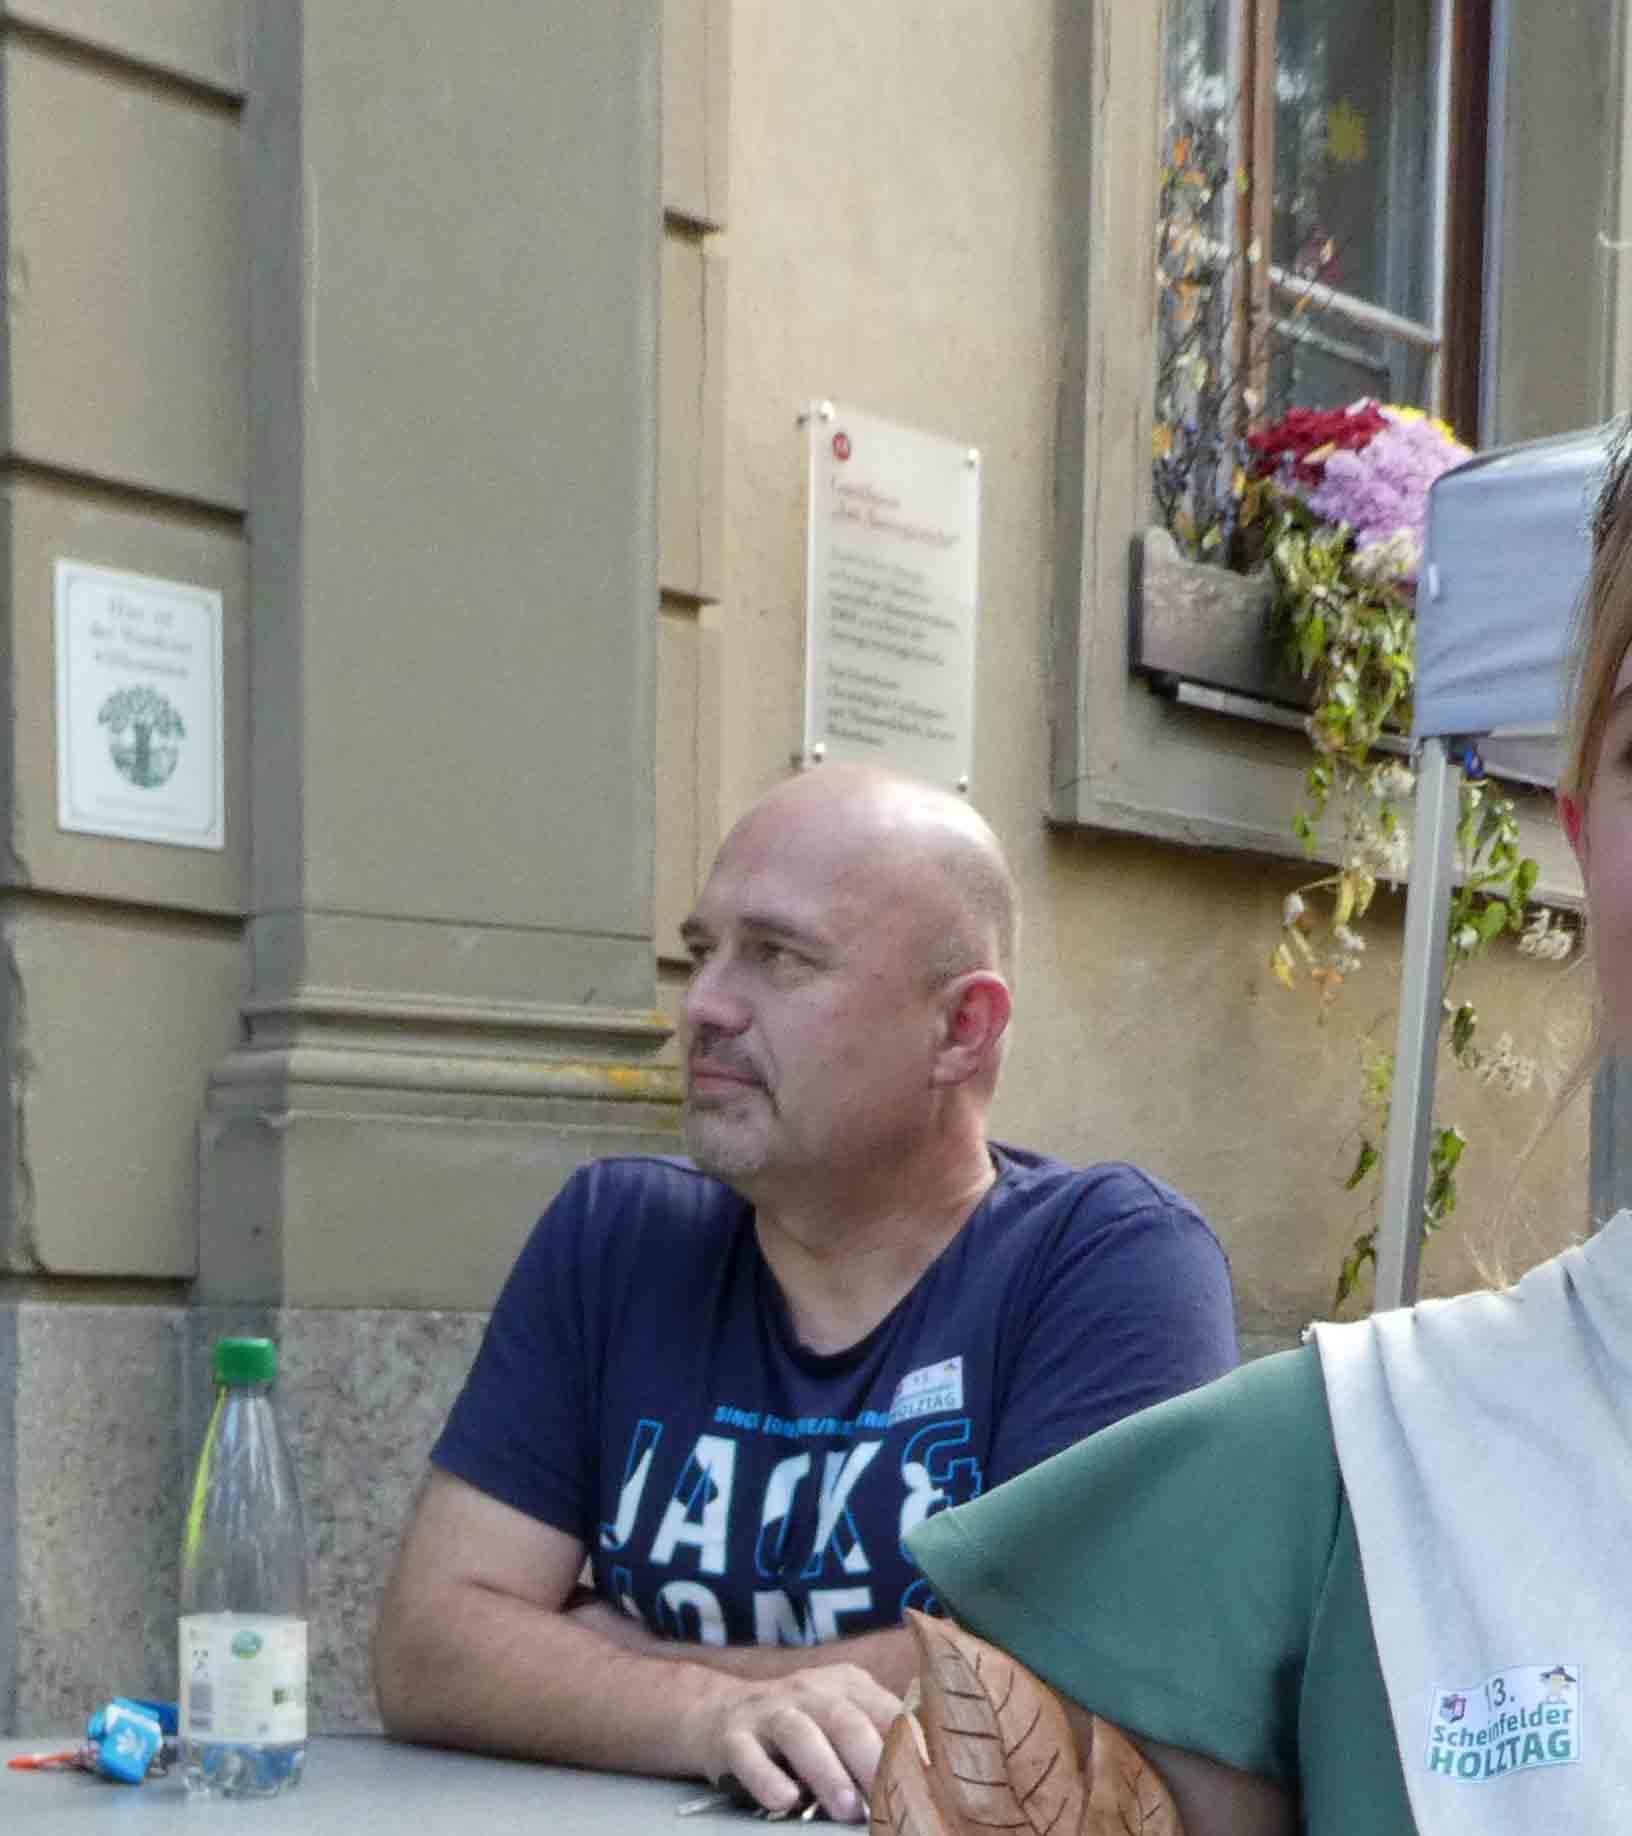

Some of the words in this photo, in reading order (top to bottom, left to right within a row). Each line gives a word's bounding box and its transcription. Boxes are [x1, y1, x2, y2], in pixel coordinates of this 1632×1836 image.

[600, 1420, 882, 1578] JACK
[1431, 1702, 1573, 1747] Scheinfelder
[1429, 1729, 1572, 1779] HOLZTAG
